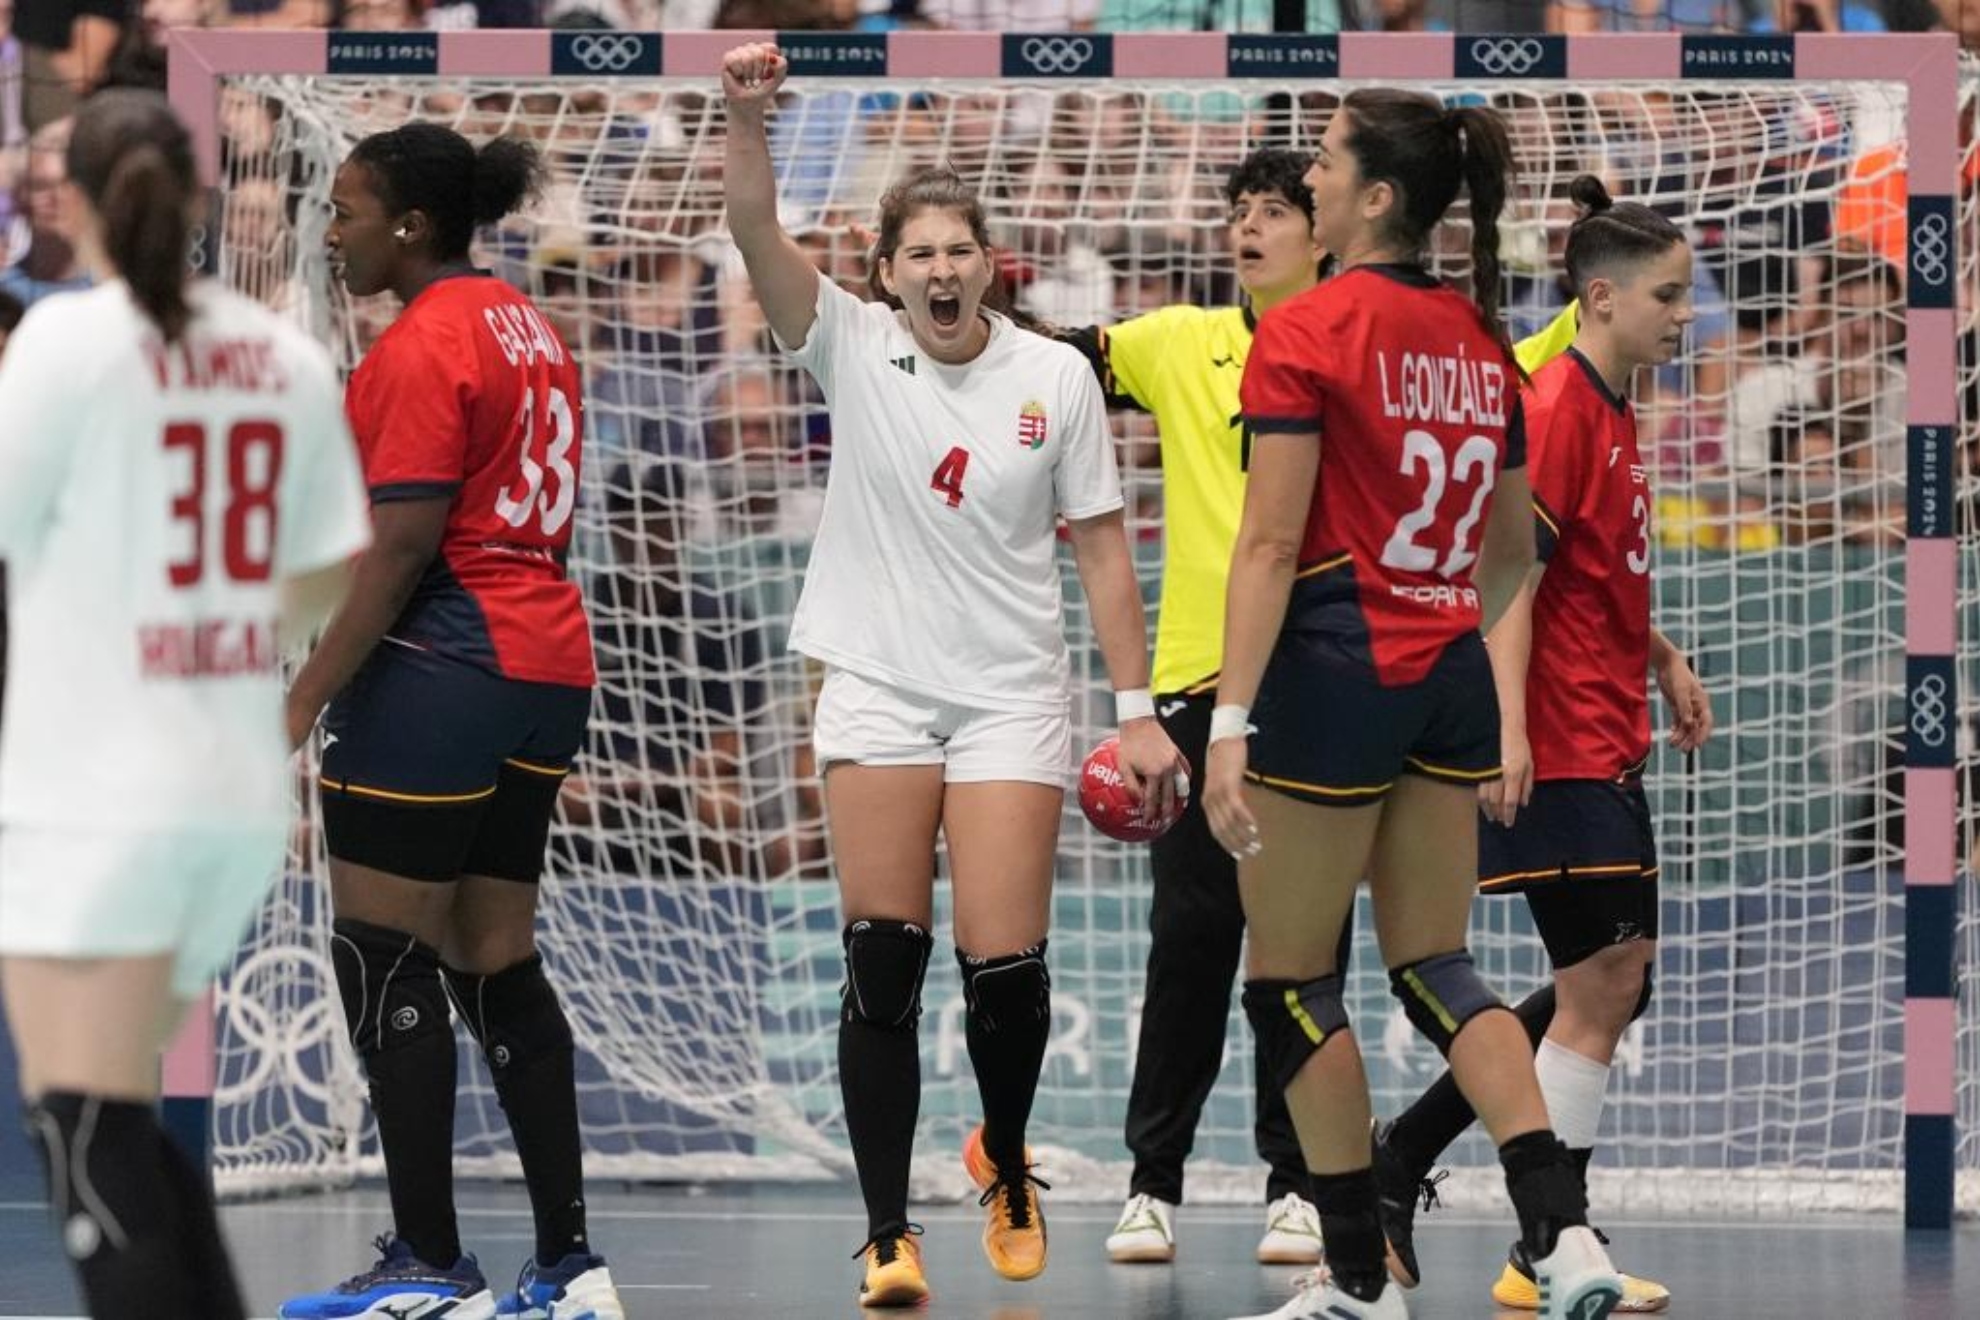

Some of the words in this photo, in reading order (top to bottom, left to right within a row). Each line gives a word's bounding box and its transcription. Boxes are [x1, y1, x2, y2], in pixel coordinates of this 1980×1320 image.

[330, 45, 384, 60] PARIS
[387, 45, 436, 60] 2024
[836, 46, 885, 62] 2024
[1230, 47, 1284, 62] PARIS
[1288, 47, 1338, 62] 2024
[1685, 50, 1738, 64] PARIS
[1743, 50, 1793, 64] 2024
[494, 386, 576, 536] 33
[931, 446, 970, 509] 4
[1923, 427, 1937, 482] PARIS
[162, 418, 285, 587] 38
[1378, 429, 1498, 579] 22
[1922, 486, 1937, 536] 2024
